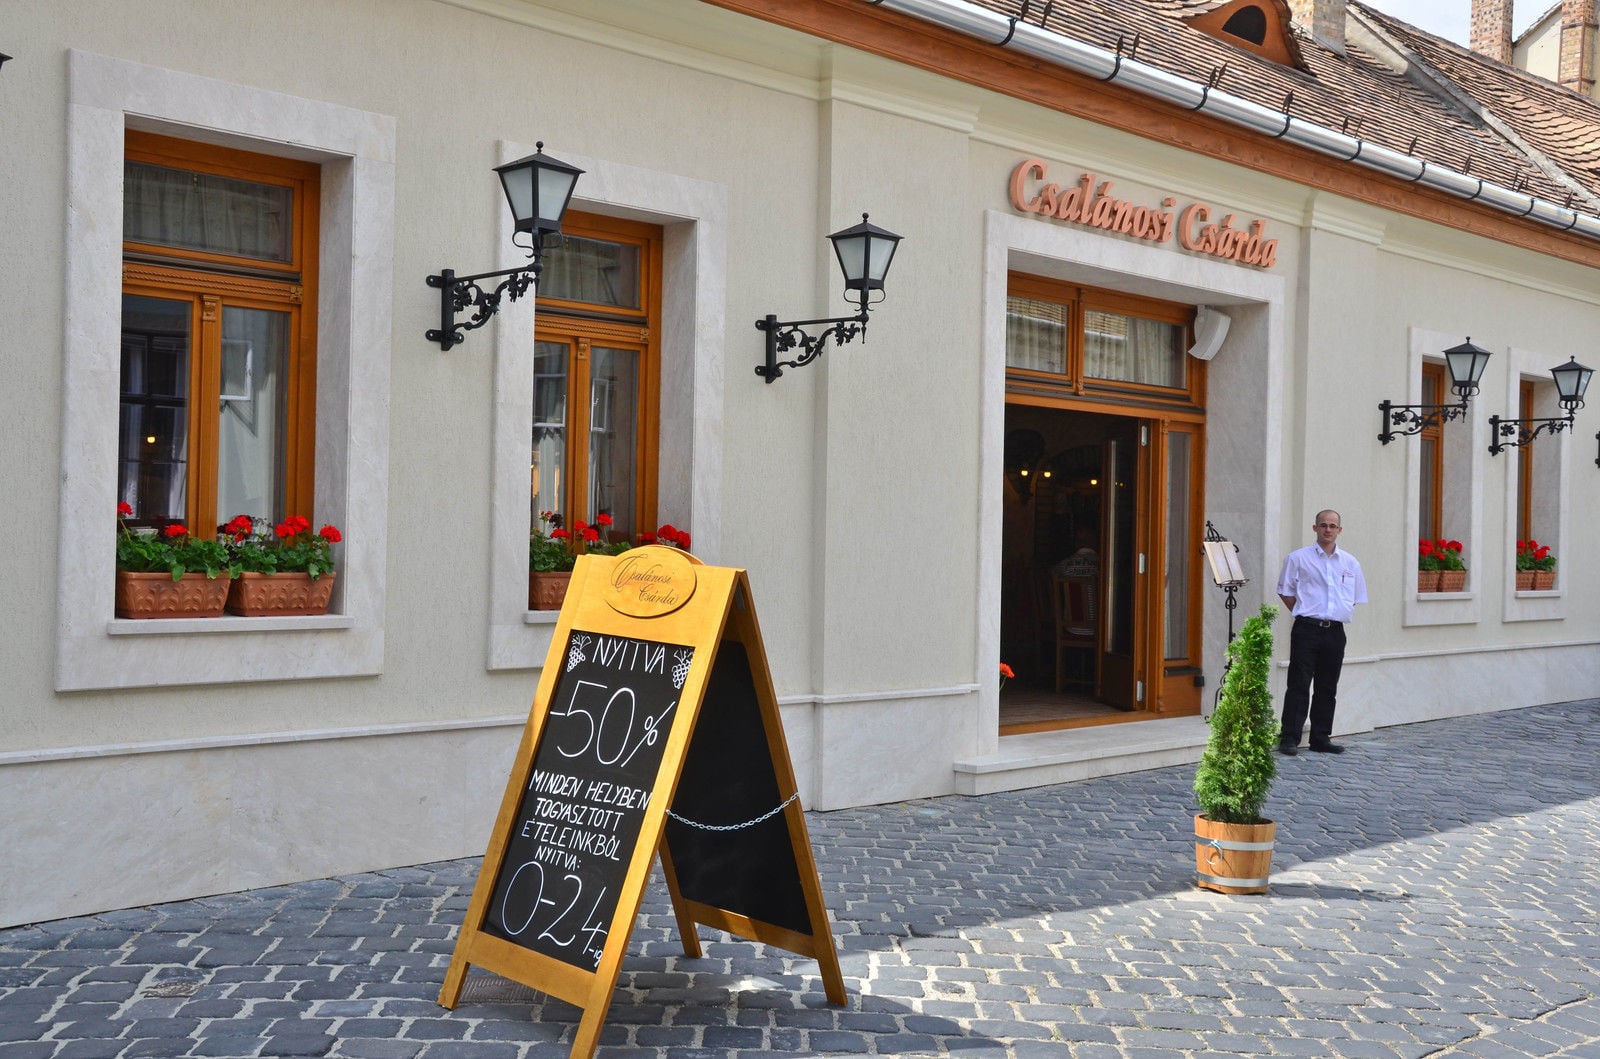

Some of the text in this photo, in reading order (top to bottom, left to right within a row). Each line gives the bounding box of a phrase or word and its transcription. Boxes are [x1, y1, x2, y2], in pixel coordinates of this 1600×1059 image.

[1009, 159, 1280, 269] Csalánosi Csárda
[592, 637, 666, 675] NYITVA
[529, 769, 653, 811] MINDEN HELYBEN
[534, 845, 583, 872] NYITVA:
